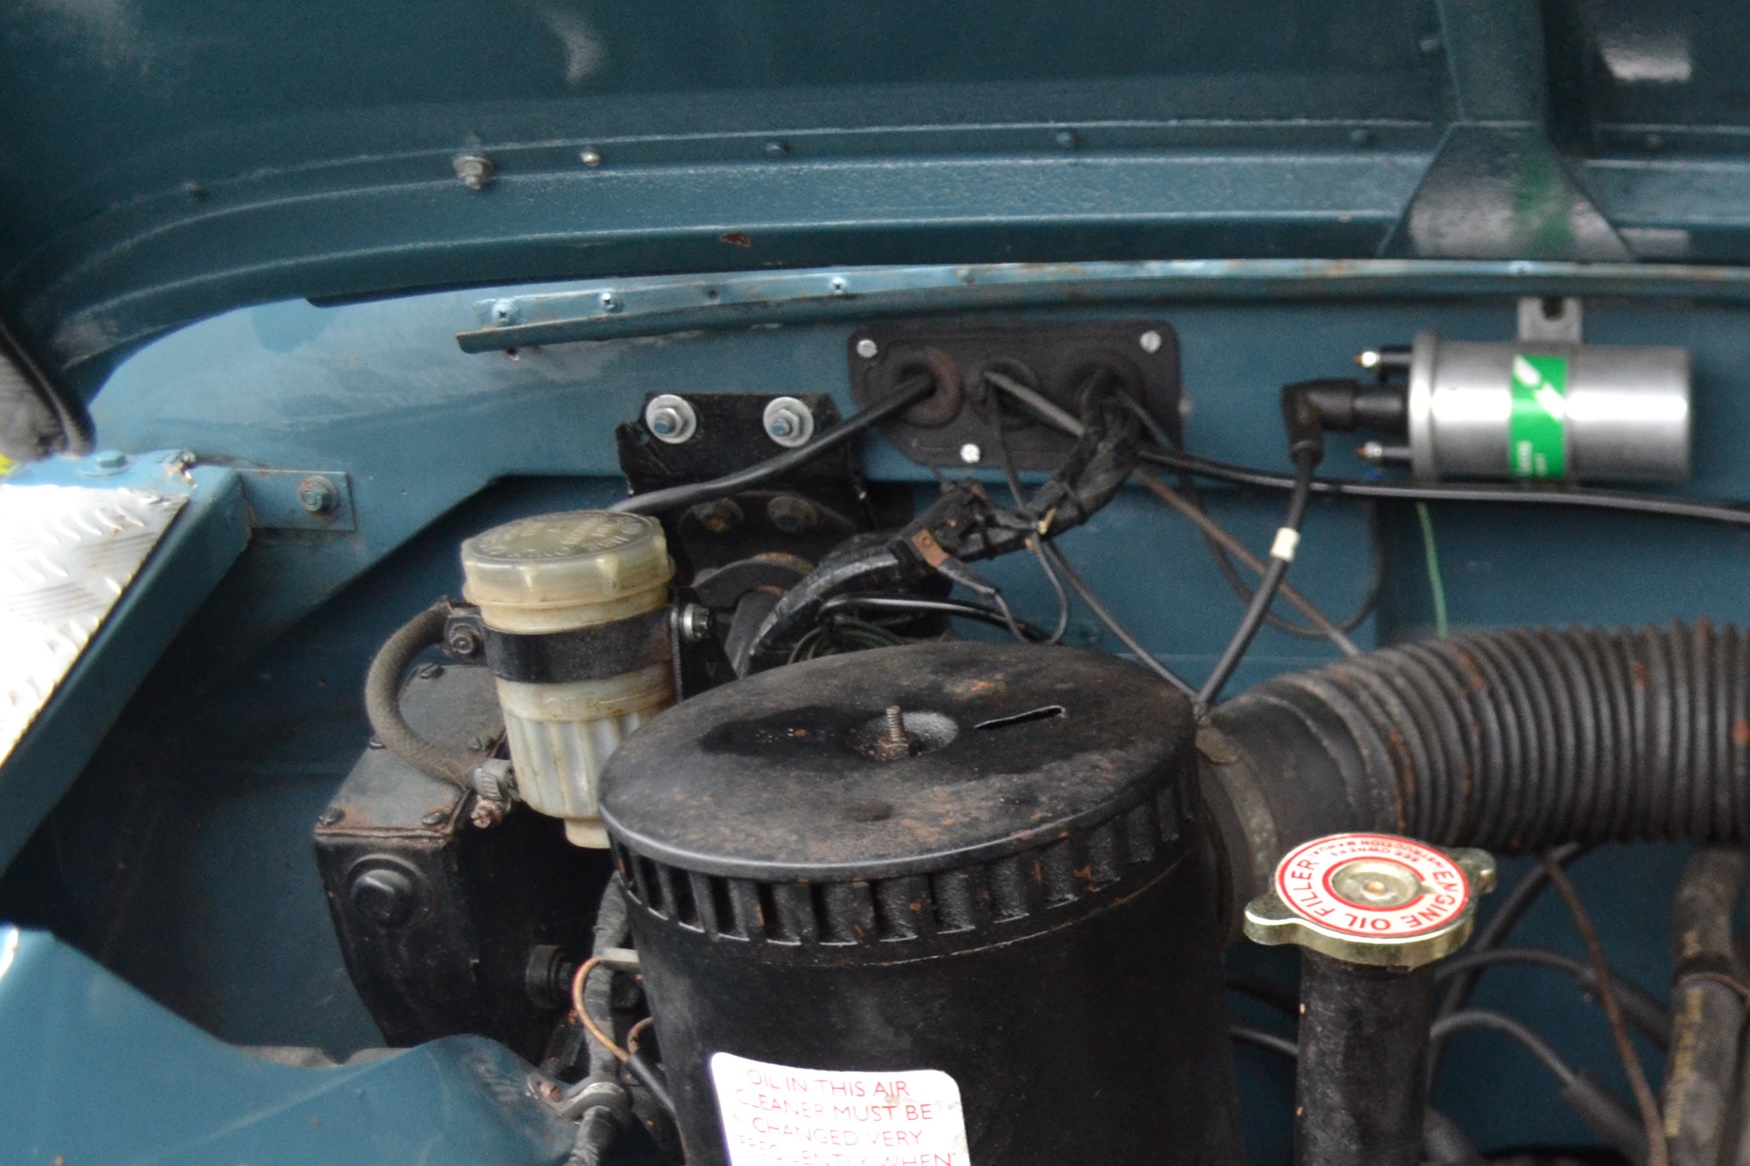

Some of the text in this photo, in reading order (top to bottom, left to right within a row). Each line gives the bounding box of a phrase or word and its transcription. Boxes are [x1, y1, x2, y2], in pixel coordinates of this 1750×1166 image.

[1290, 858, 1457, 931] ENGINE OIL FILLER
[747, 1069, 910, 1097] OIL IN THIS AIR
[735, 1089, 933, 1122] CLEANER MUST BE
[752, 1117, 923, 1146] CHANGED VERY
